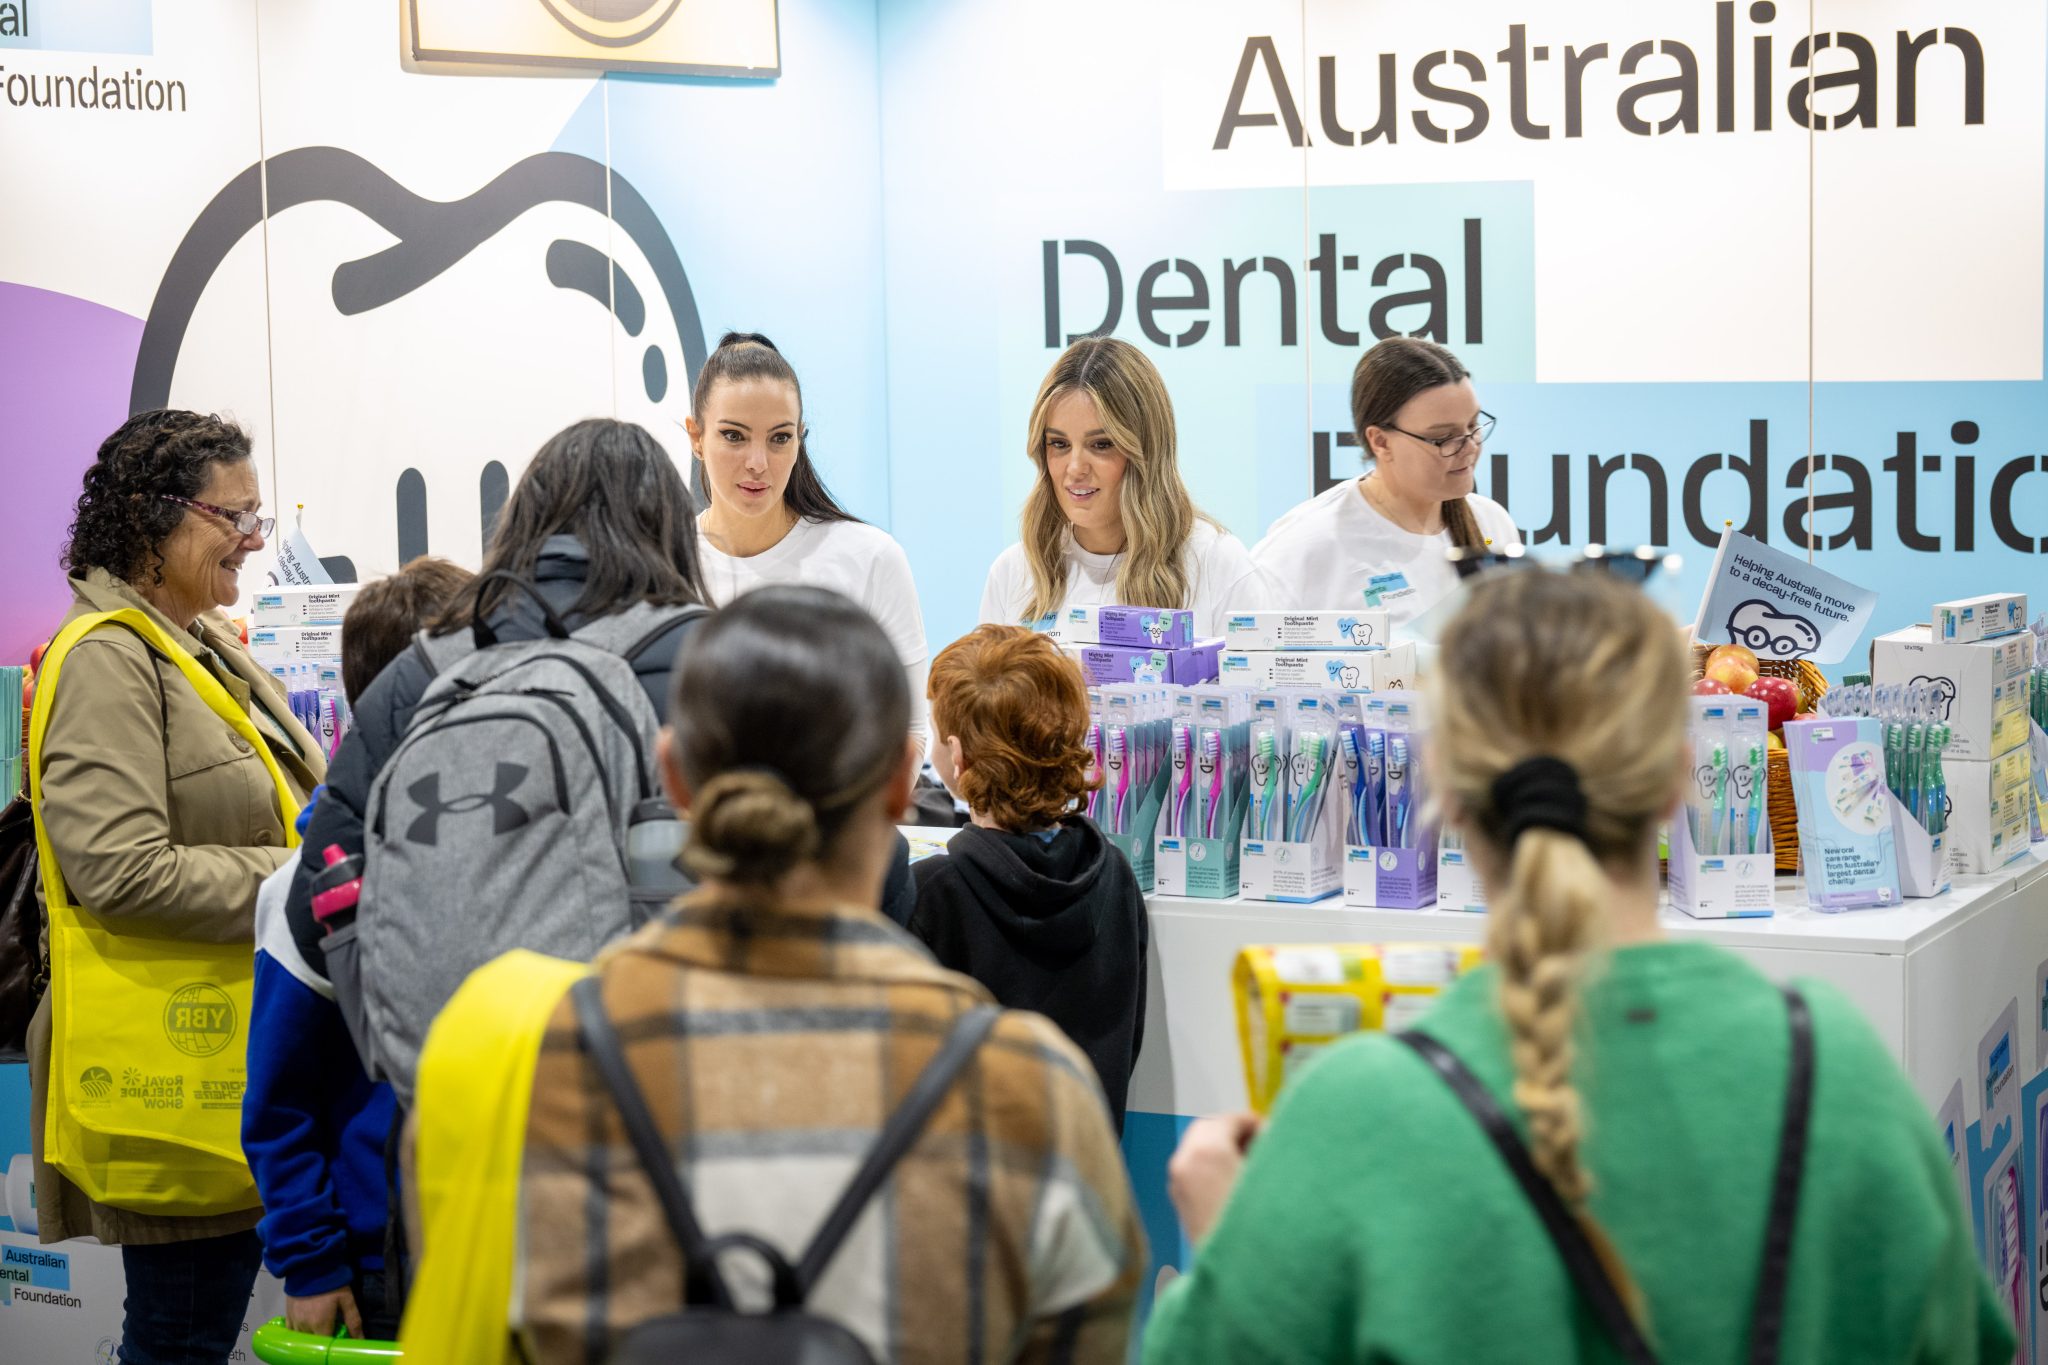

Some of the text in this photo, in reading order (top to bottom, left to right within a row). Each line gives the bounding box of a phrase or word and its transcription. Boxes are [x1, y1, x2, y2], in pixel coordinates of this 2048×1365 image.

[1213, 0, 1985, 151] Australian
[1042, 218, 1484, 349] Dental
[1730, 566, 1849, 623] to a decay-free future.
[1734, 553, 1855, 613] Helping Australia move
[0, 1268, 29, 1283] ental
[5, 1249, 66, 1270] Australian
[14, 1287, 81, 1309] Foundation
